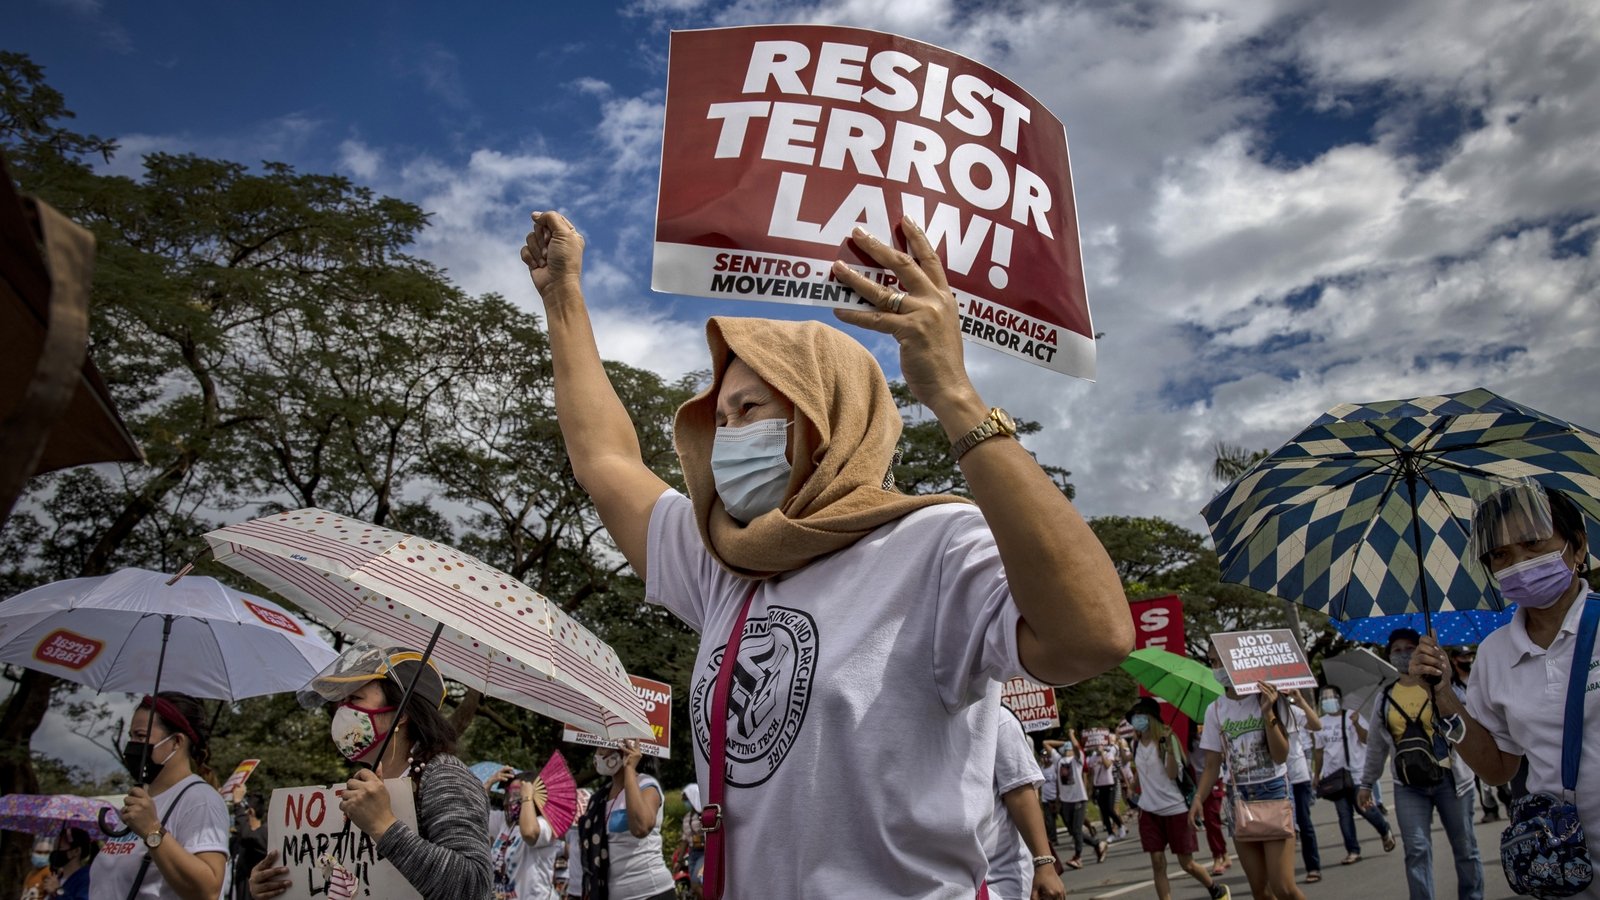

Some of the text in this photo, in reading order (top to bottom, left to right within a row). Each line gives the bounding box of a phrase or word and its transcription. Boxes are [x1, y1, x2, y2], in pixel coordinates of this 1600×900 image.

[741, 40, 1030, 153] RESIST
[707, 101, 1054, 240] TERROR
[767, 171, 1014, 290] LAW!
[713, 253, 811, 279] SENTRO
[710, 274, 856, 303] MOVEMENT
[959, 314, 1057, 363] ERROR ACT
[968, 299, 1058, 346] NAGKAISA
[1229, 642, 1292, 659] EXPENSIVE
[1237, 633, 1273, 648] NO TO
[1232, 652, 1299, 670] MEDICINES!
[633, 686, 670, 704] UHAY
[693, 674, 710, 753] ATEWAY
[707, 653, 724, 672] TO
[768, 646, 813, 771] ARCHITECTURE
[1002, 692, 1046, 711] SAHOD
[757, 718, 782, 748] TECH.
[285, 791, 326, 830] NO
[308, 861, 371, 897] L!
